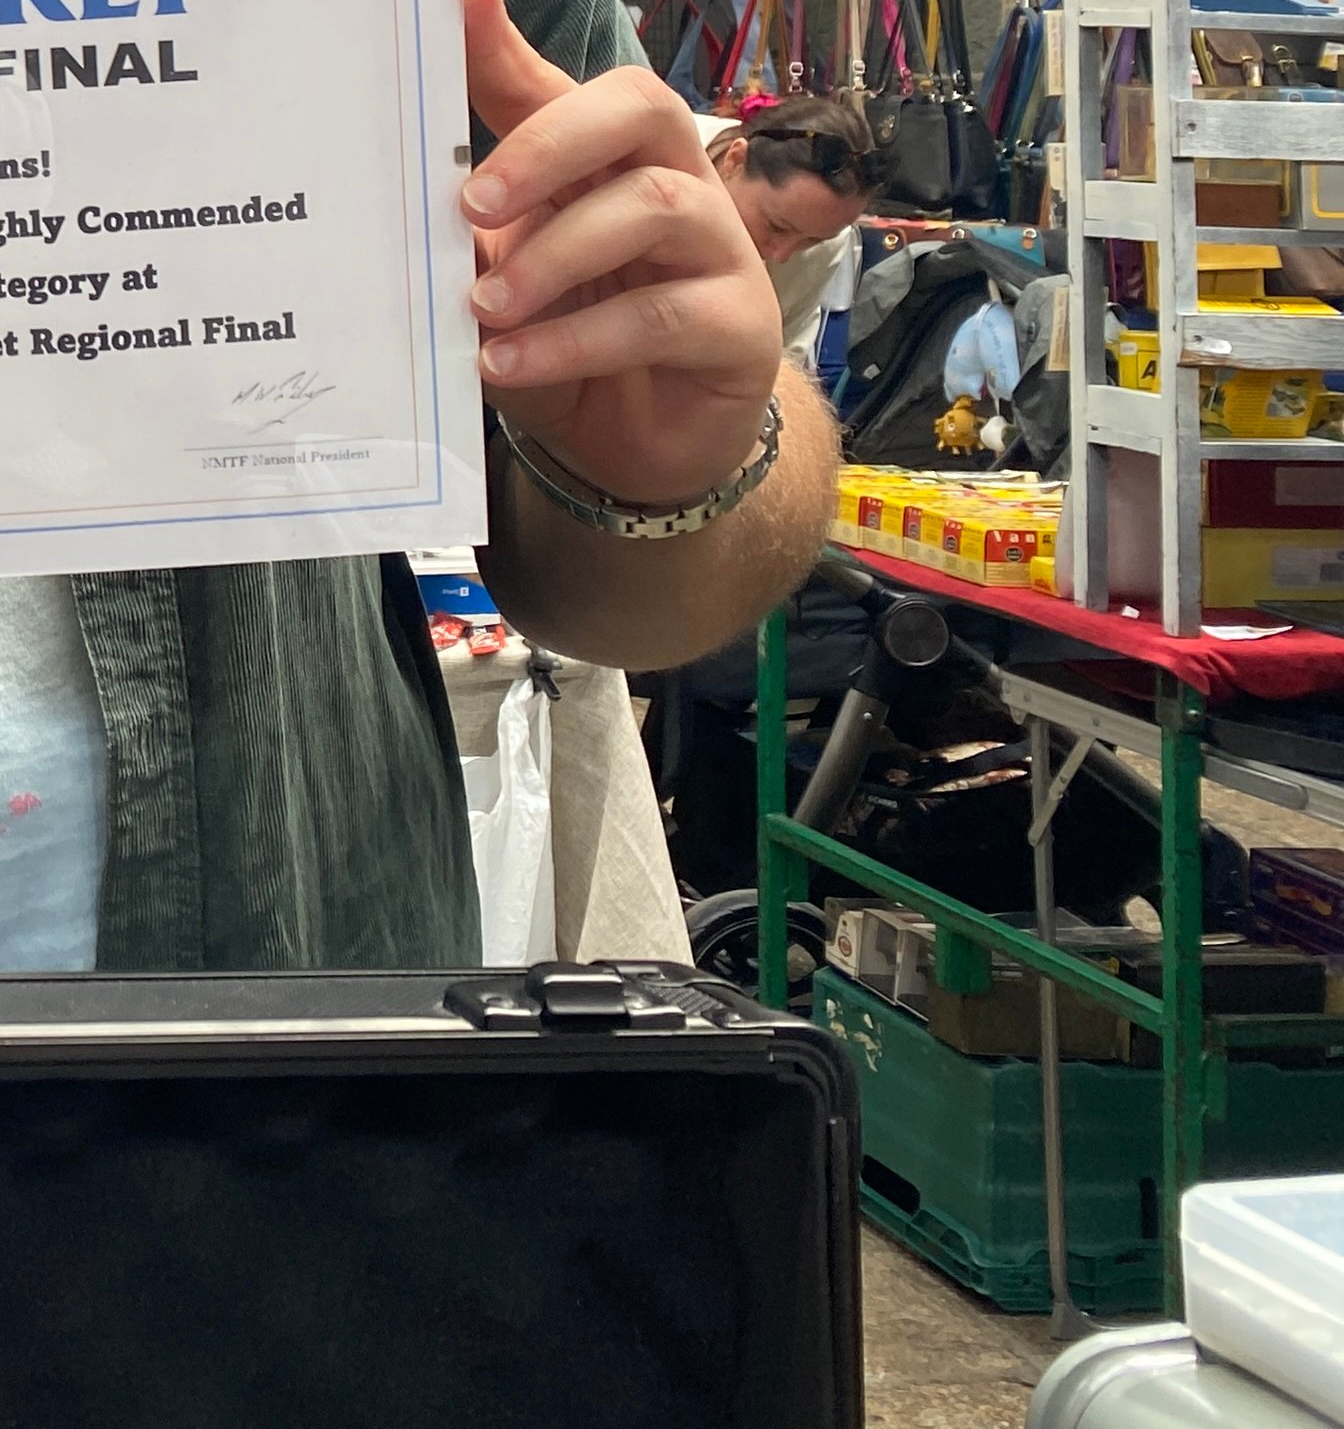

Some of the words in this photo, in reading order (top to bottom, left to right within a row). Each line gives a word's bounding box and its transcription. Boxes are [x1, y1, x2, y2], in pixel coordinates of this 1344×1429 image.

[77, 192, 308, 234] Commended
[122, 263, 159, 292] at
[30, 318, 192, 360] Regional
[202, 312, 297, 344] Final
[201, 455, 249, 470] NMTF
[252, 452, 307, 467] National
[311, 448, 371, 464] President
